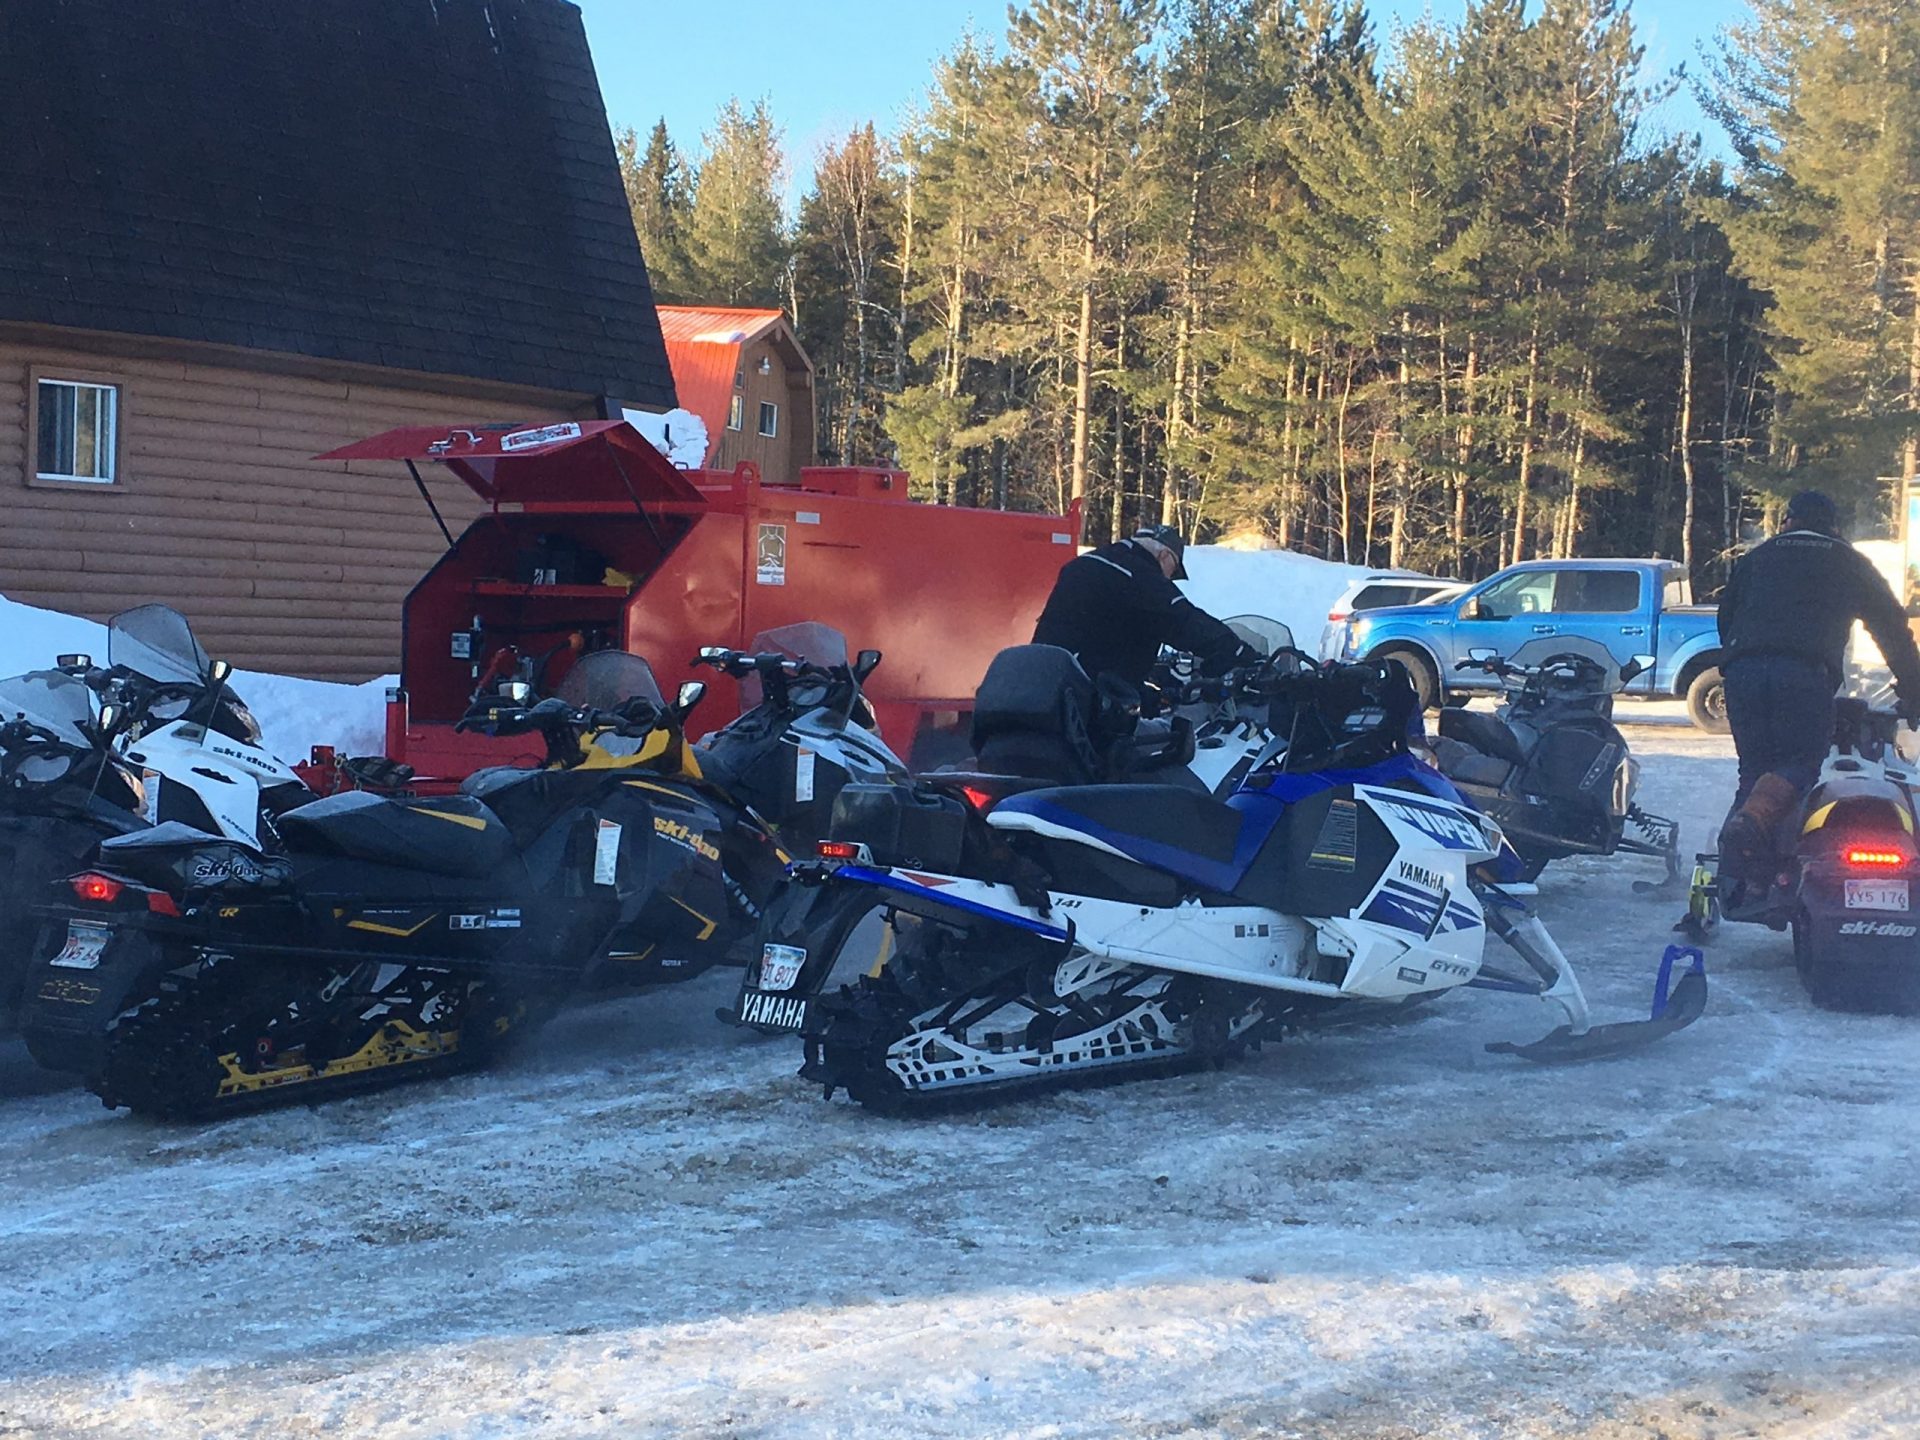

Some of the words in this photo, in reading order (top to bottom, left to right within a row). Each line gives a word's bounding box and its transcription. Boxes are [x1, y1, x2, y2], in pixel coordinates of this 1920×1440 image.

[213, 746, 277, 774] ski-doo
[654, 817, 719, 860] ski-doo
[194, 860, 262, 879] skidoo
[1400, 861, 1445, 892] YAMAHA
[1055, 898, 1082, 909] 141
[1881, 891, 1906, 906] 176
[1839, 921, 1917, 937] ski-doo
[1430, 960, 1471, 978] GYTR
[741, 993, 806, 1029] YAMAHA
